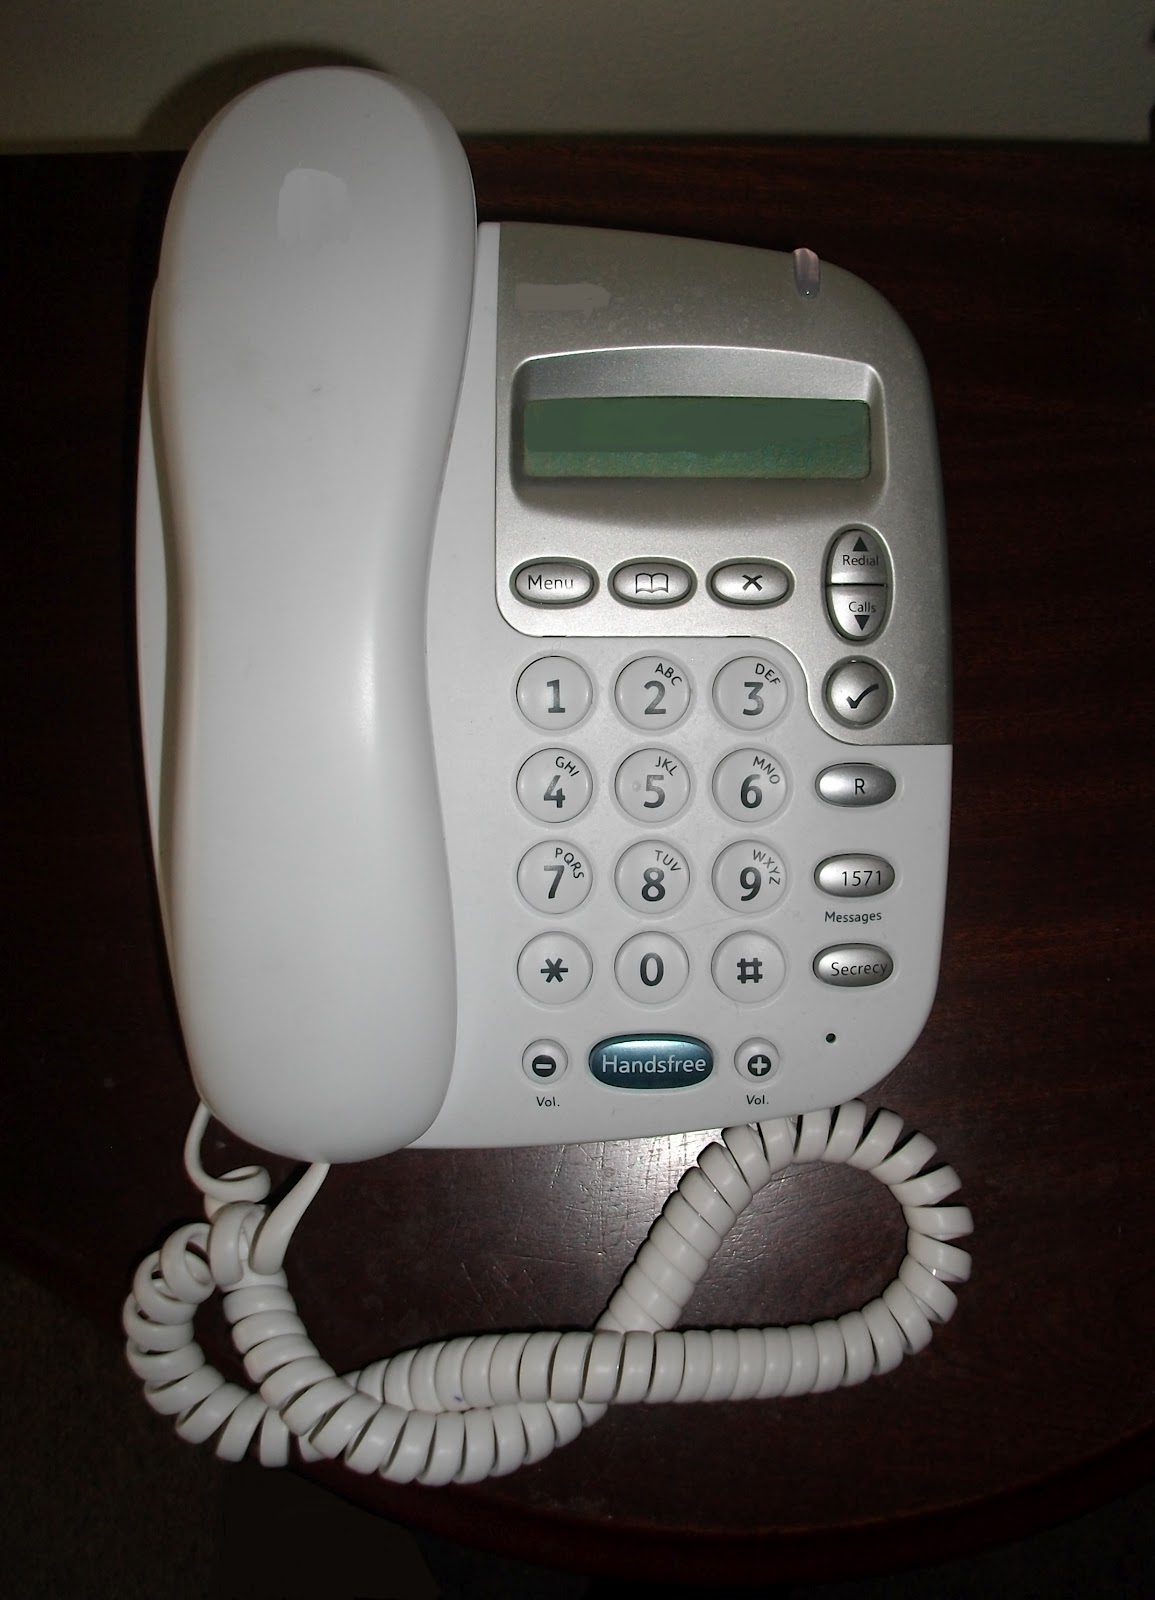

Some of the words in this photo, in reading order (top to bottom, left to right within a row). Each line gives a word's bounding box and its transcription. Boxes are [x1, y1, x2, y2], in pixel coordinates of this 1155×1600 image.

[842, 554, 879, 567] Redial
[528, 574, 574, 590] Menu
[848, 601, 877, 614] Calls
[655, 662, 683, 687] ABC
[755, 662, 781, 686] DEF
[546, 679, 566, 714] 1
[643, 680, 667, 715] 2
[742, 681, 765, 716] 3
[555, 756, 580, 778] GHI
[654, 756, 677, 777] JKL
[752, 755, 781, 786] MNO
[543, 774, 566, 809] 4
[643, 774, 666, 809] 5
[740, 773, 763, 809] 6
[854, 778, 865, 795] R
[554, 847, 585, 880] PQRS
[654, 849, 682, 873] TUV
[752, 849, 781, 886] WXYZ
[543, 864, 565, 900] 7
[641, 866, 666, 902] 8
[739, 866, 762, 902] 9
[841, 870, 882, 887] 1571
[824, 910, 882, 924] Messages
[639, 952, 665, 987] 0
[830, 961, 888, 977] Secrecy
[601, 1055, 707, 1074] Handsfree
[536, 1096, 560, 1108] Vol.
[746, 1094, 770, 1106] Vol.
